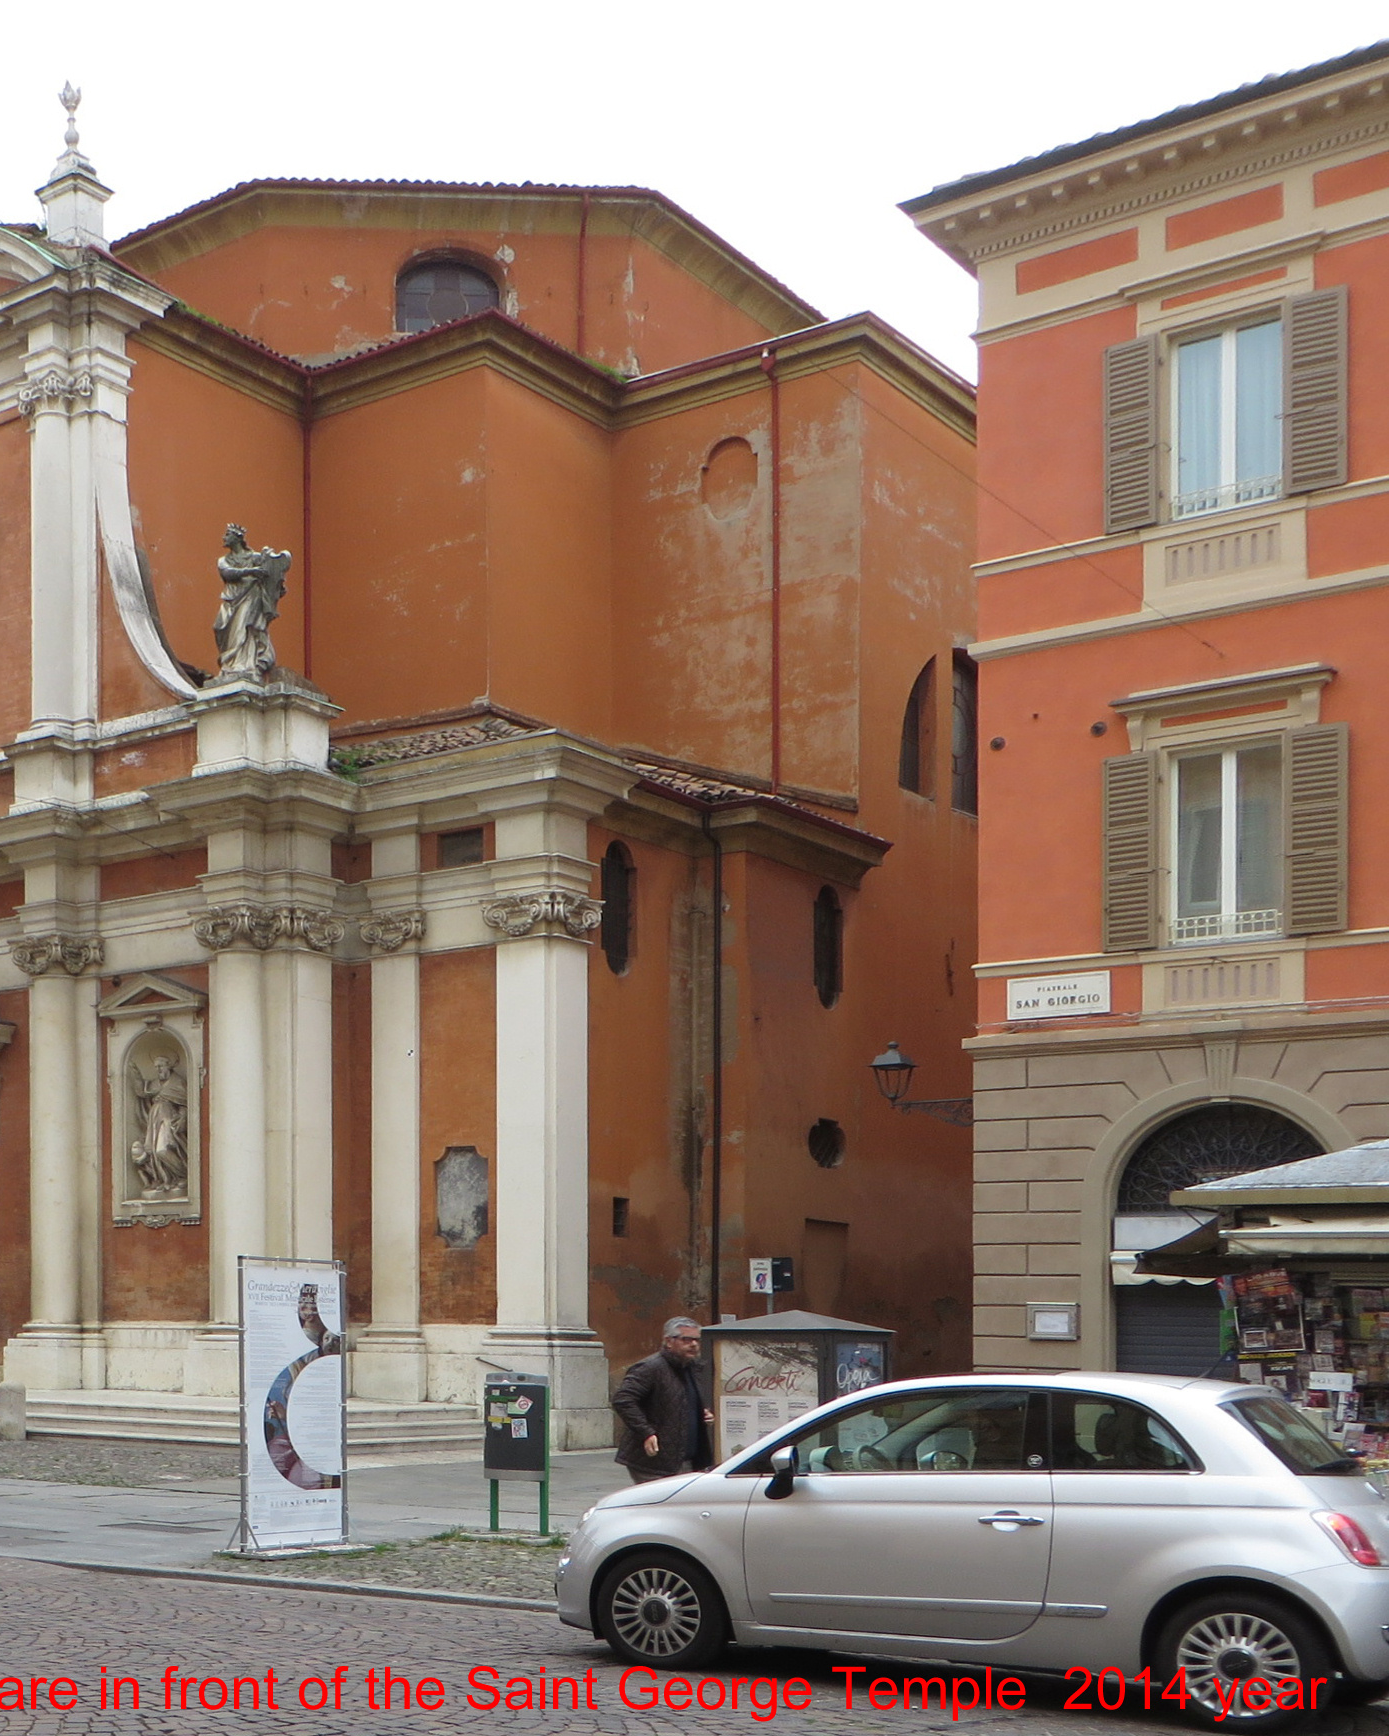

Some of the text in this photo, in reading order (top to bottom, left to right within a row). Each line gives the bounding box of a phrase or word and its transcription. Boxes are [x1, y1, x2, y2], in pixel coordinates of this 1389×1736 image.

[1037, 984, 1078, 992] PIAZZALE
[1016, 994, 1101, 1009] SAN GIORGIO
[260, 1293, 282, 1302] Festival
[724, 1366, 805, 1394] Concerti
[836, 1363, 879, 1392] Opera
